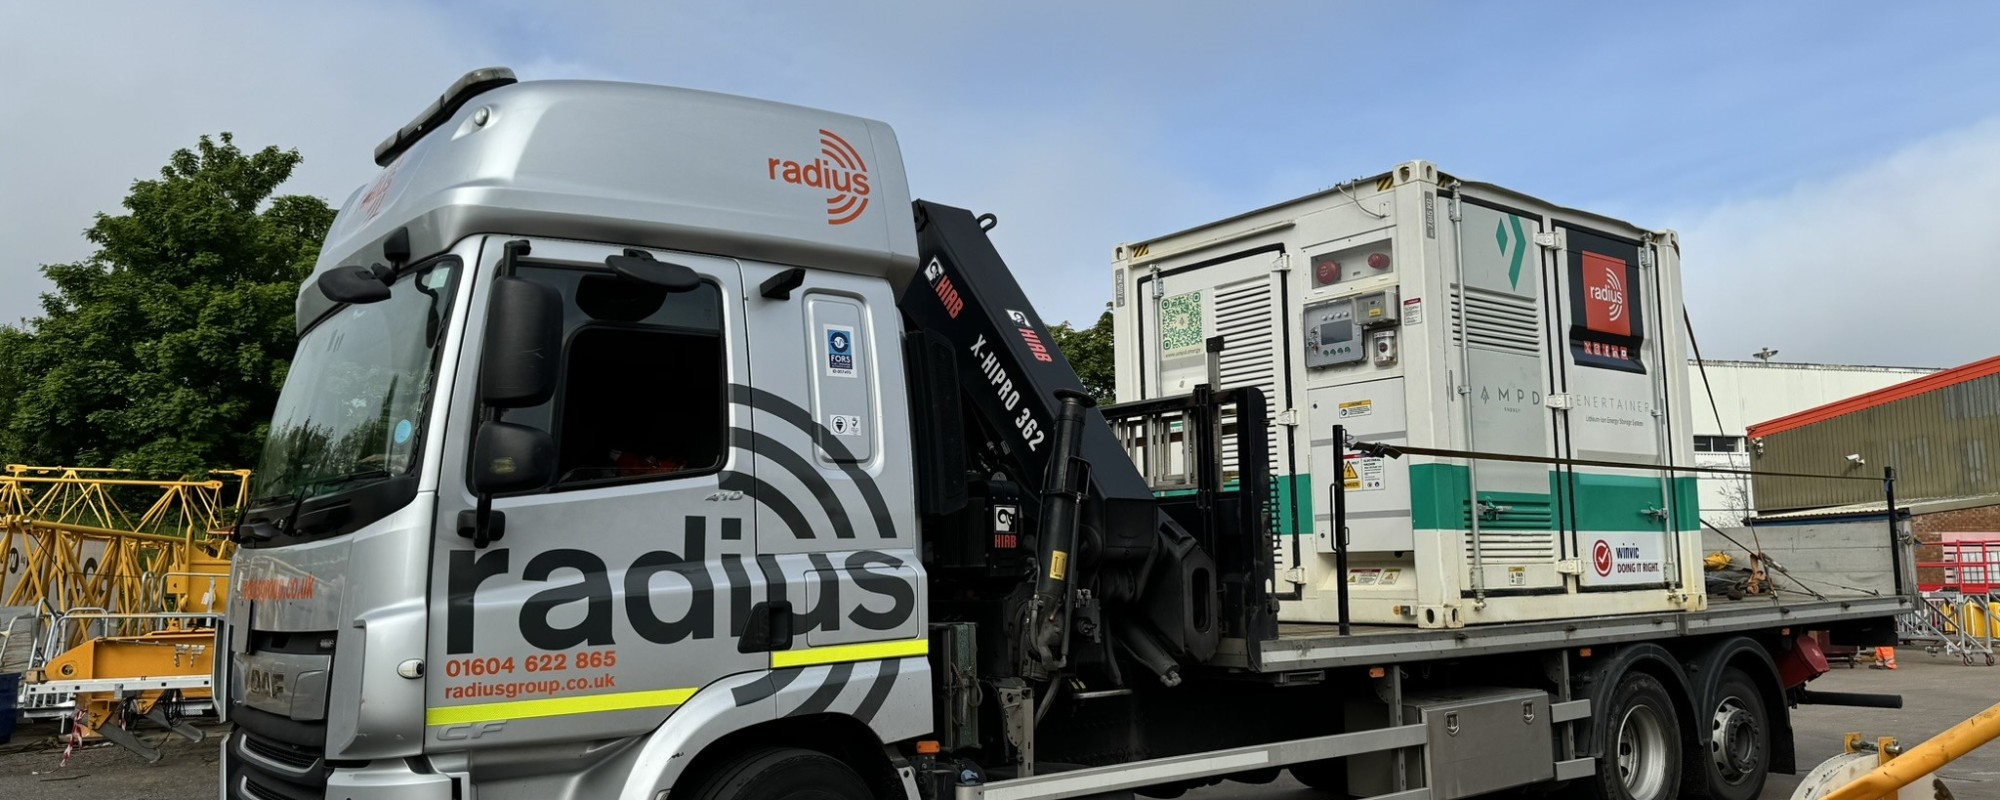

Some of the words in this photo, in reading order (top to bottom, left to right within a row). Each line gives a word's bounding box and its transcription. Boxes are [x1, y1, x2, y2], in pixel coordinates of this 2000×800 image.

[768, 158, 870, 196] radius
[935, 275, 965, 319] HIAB
[1589, 285, 1623, 305] radius
[1018, 327, 1052, 363] HIAB
[830, 354, 851, 364] FORS
[969, 333, 1020, 411] X-HIPRO
[1015, 408, 1045, 451] 362
[1576, 394, 1650, 413] ENERTAINER
[994, 534, 1017, 548] HIAB
[1615, 542, 1640, 559] winvic
[1617, 563, 1636, 573] DOING
[1637, 563, 1642, 572] IT
[1643, 562, 1660, 572] RIGHT.
[446, 515, 916, 655] radius
[446, 656, 515, 677] 01604
[525, 653, 567, 672] 622
[575, 650, 617, 669] 865
[445, 673, 615, 699] radiusgroup.co.uk
[437, 719, 507, 741] CF
